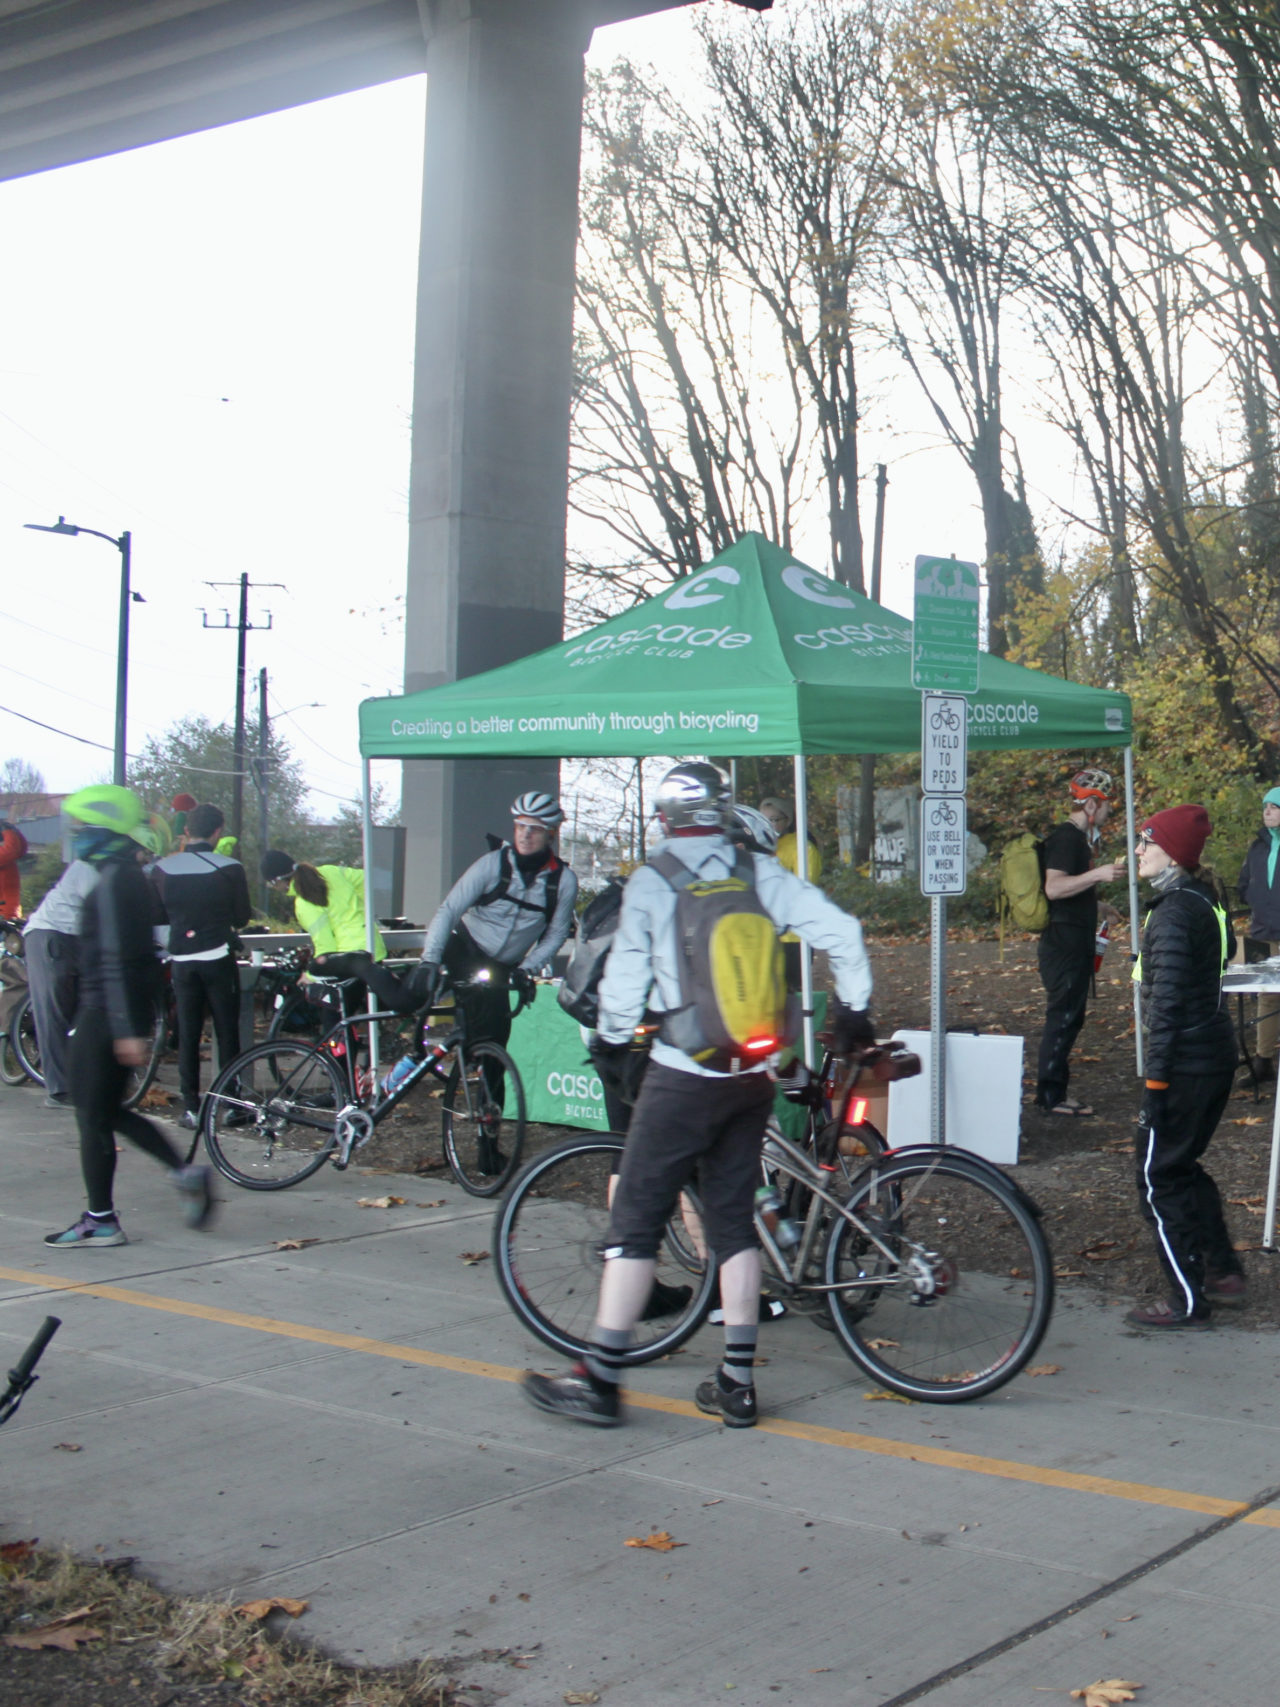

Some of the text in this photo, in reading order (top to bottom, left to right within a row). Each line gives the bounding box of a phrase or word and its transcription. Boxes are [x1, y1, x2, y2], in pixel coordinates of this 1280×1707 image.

[643, 645, 695, 660] CLUB
[966, 699, 1039, 724] cascade
[391, 710, 760, 739] Creating a better community through bicycling
[931, 734, 959, 749] YIELD
[939, 752, 951, 766] TO
[932, 769, 957, 784] PEDS
[926, 830, 961, 842] USE BELL
[927, 844, 961, 856] OR VOICE
[934, 858, 954, 870] WHEN
[928, 872, 959, 884] PASSING
[546, 1071, 603, 1101] casc
[565, 1103, 604, 1120] BICYCLE
